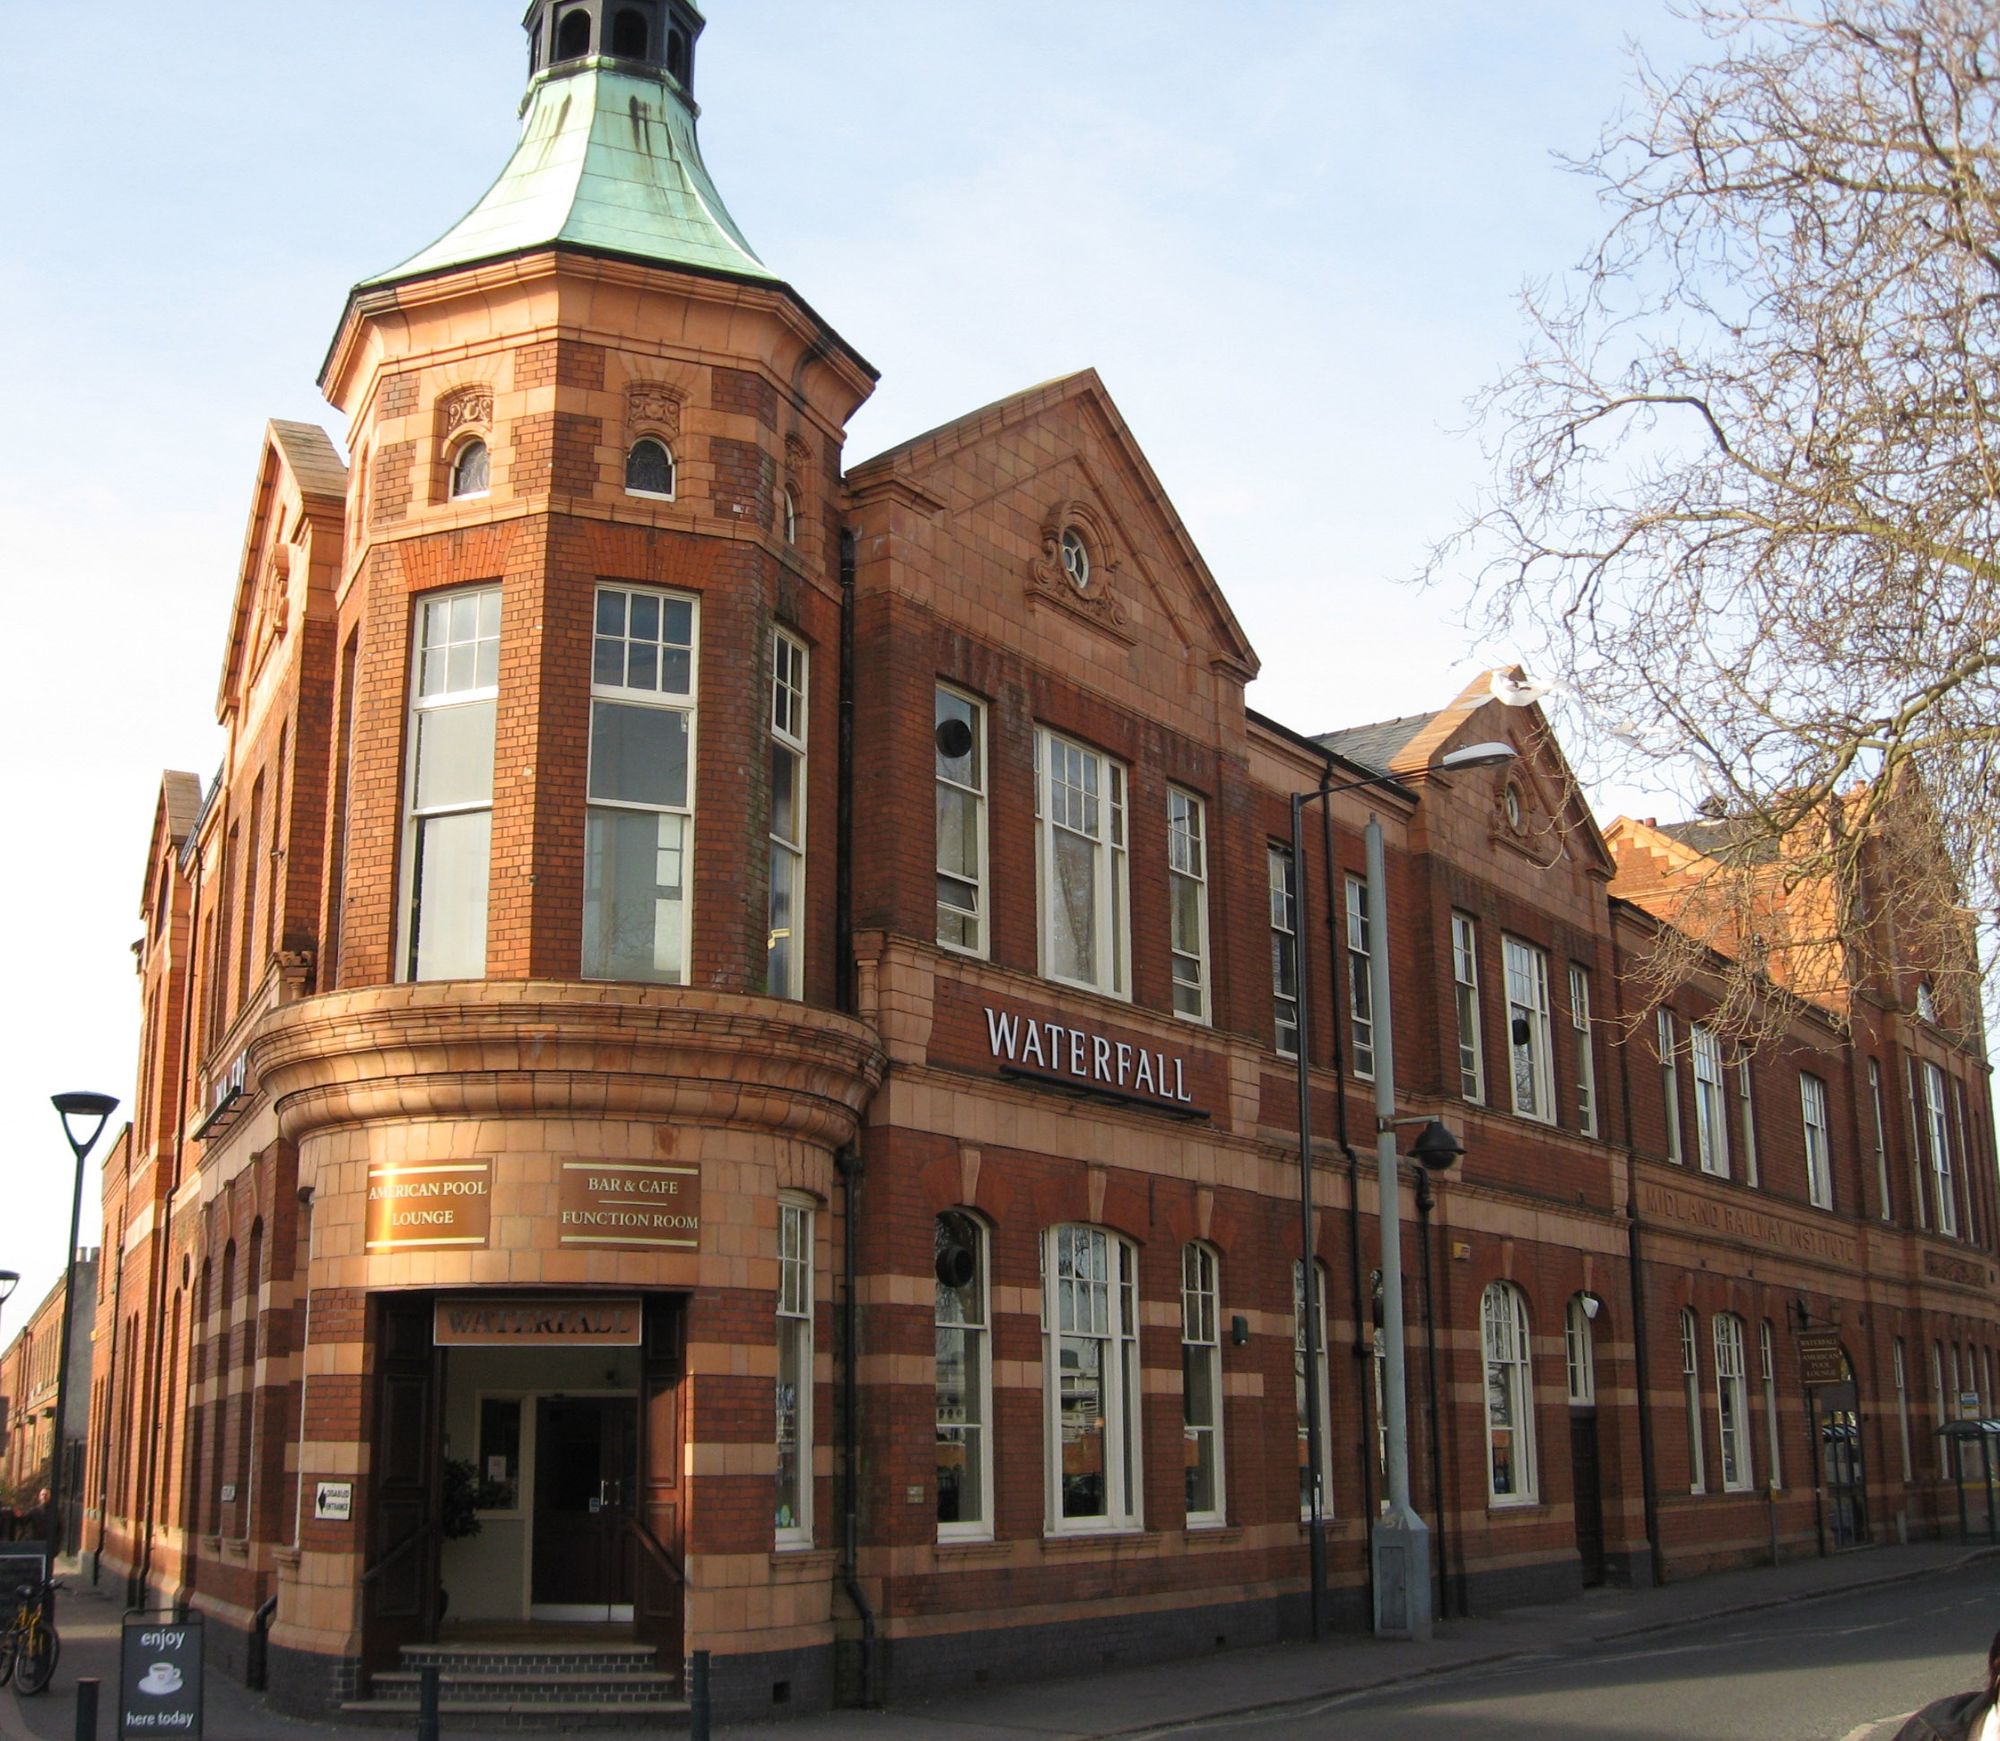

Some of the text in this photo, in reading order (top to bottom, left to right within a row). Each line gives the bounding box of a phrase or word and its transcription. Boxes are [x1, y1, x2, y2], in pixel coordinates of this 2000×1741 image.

[984, 1007, 1192, 1102] WATERFALL
[368, 1181, 487, 1200] AMERICAN POOL
[588, 1177, 679, 1195] BAR & CAFE
[392, 1210, 454, 1226] LOUNGE
[562, 1211, 699, 1229] FUNCTION ROOM
[1646, 1185, 1854, 1262] MIDLAND RAILWAY INSTITUTE
[449, 1310, 630, 1334] WATERFALL
[141, 1628, 185, 1651] enjoy
[126, 1710, 194, 1728] here today
